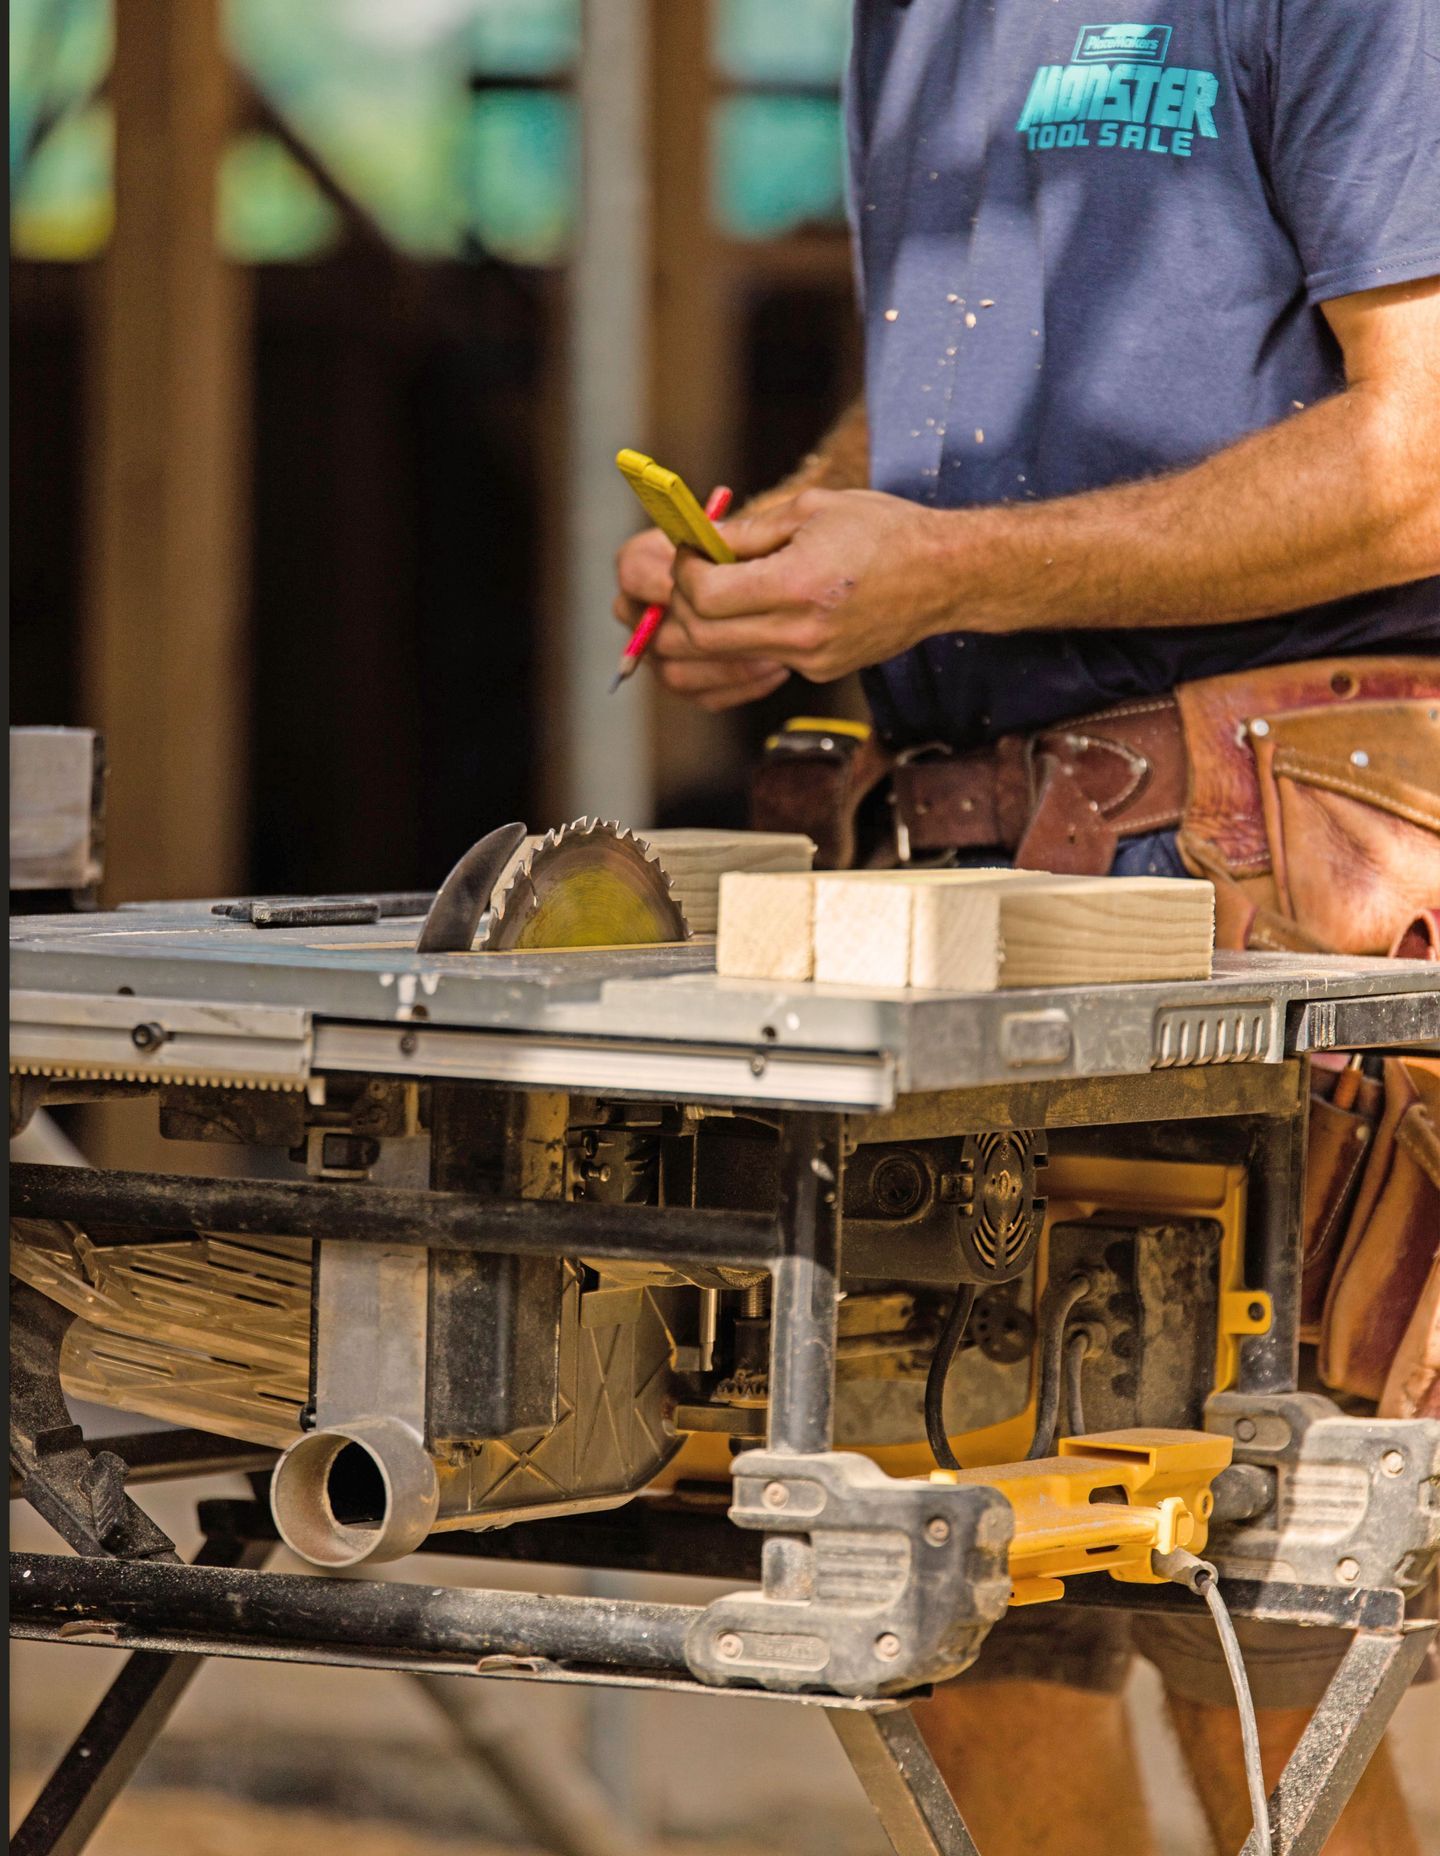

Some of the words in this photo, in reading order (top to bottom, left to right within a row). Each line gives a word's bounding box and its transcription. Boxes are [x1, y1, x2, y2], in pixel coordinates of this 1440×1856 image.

[1084, 35, 1159, 50] PlaceMakers
[1015, 64, 1219, 139] MONSTER
[1028, 124, 1090, 151] TOOL
[1097, 122, 1194, 157] SALE
